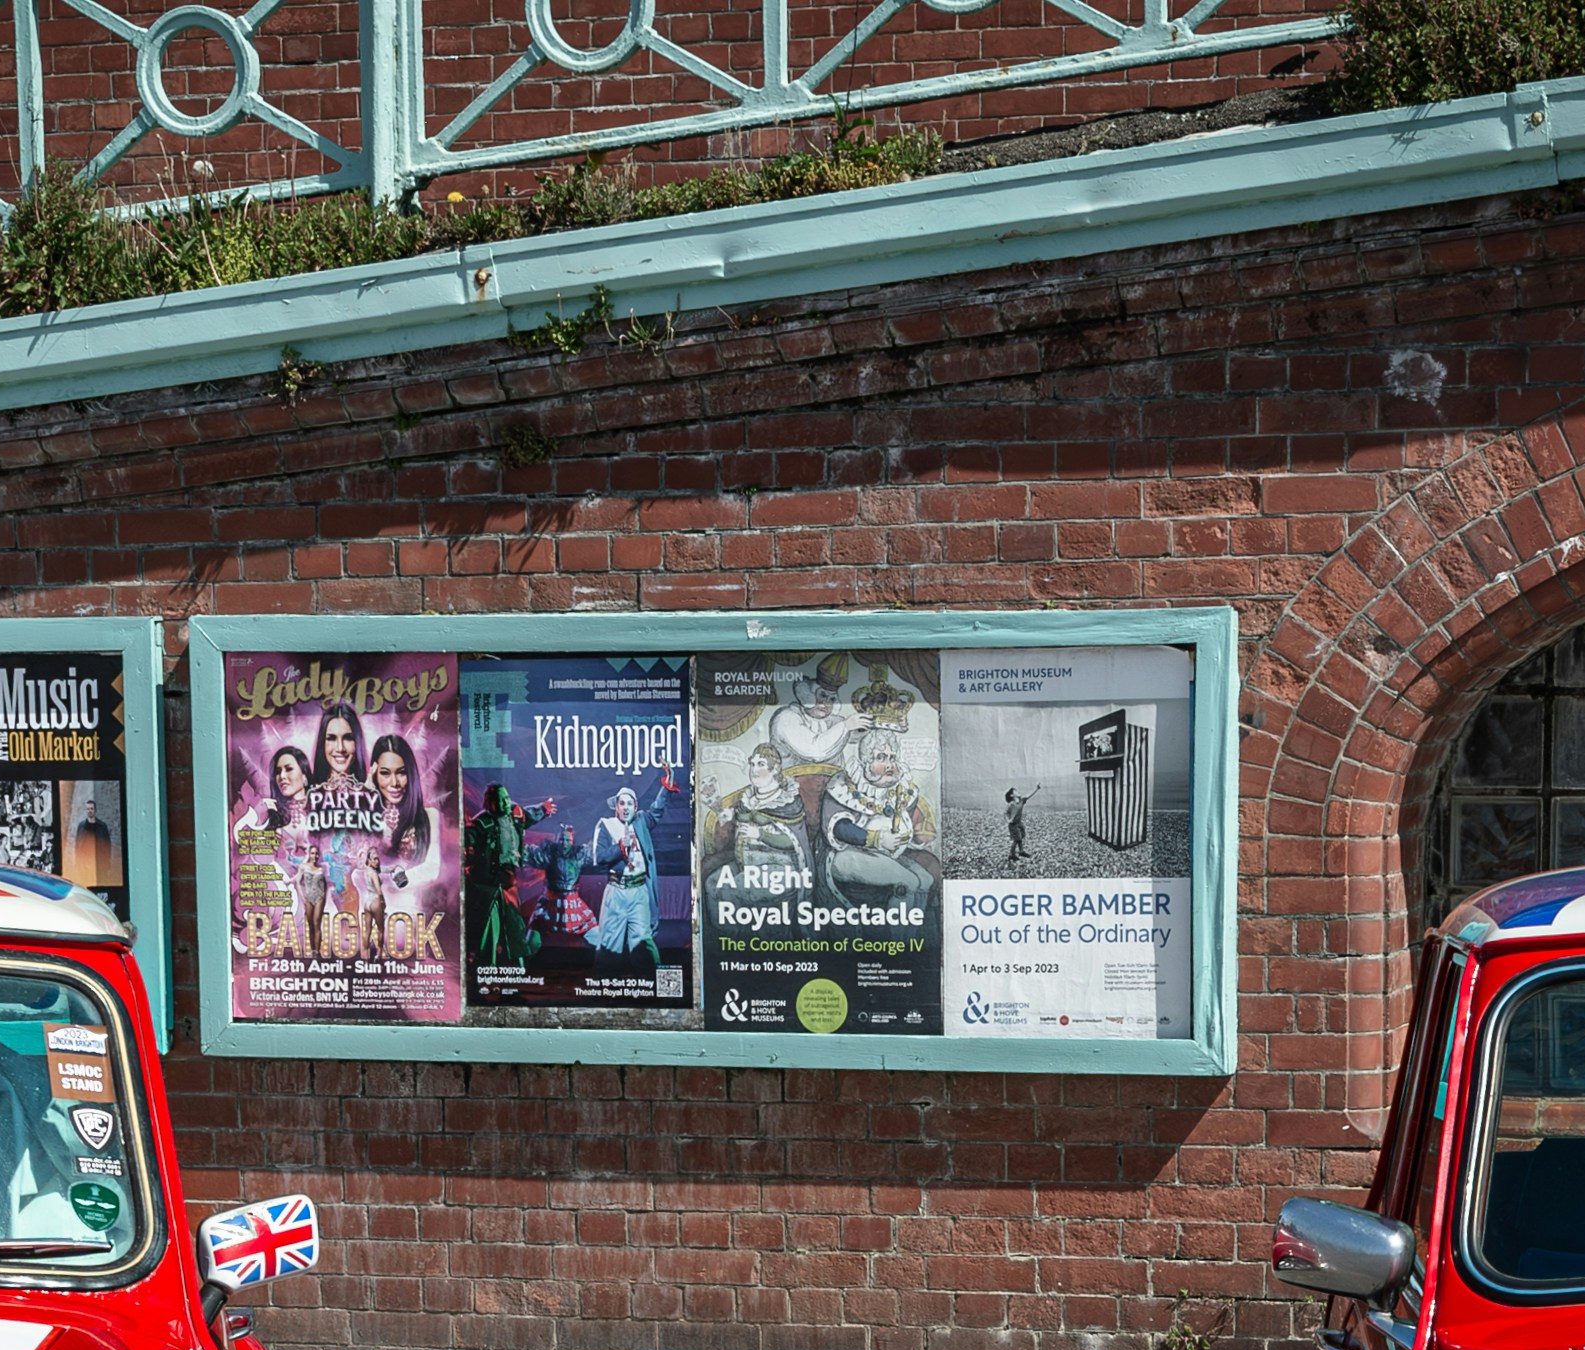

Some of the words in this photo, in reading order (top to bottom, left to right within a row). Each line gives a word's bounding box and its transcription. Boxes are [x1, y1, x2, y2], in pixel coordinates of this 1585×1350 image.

[283, 664, 301, 683] The
[714, 671, 751, 683] ROYAL
[752, 671, 804, 683] PAVILION
[958, 669, 1019, 680] BRIGHTON
[1021, 667, 1073, 679] MUSEUM
[236, 660, 351, 721] Lady
[345, 664, 449, 715] Boys
[548, 679, 553, 690] A
[618, 678, 647, 688] adventure
[647, 678, 663, 688] based
[671, 678, 681, 688] the
[714, 685, 723, 696] &
[724, 684, 772, 696] GARDEN
[958, 682, 967, 693] &
[969, 682, 991, 693] ART
[993, 681, 1044, 692] GALLERY
[610, 690, 617, 700] by
[617, 689, 636, 700] Robert
[637, 689, 652, 700] Louis
[652, 690, 681, 699] Stevenson
[483, 693, 491, 733] Brighton
[9, 731, 37, 762] Old
[38, 731, 101, 762] Market
[533, 714, 685, 776] Kidnapped
[309, 790, 380, 811] PARTY
[306, 809, 385, 833] QUEENS
[716, 865, 737, 889] A
[743, 864, 813, 895] Right
[961, 895, 1053, 917] ROGER
[1062, 893, 1171, 916] BAMBER
[718, 901, 792, 932] Royal
[797, 901, 925, 932] Spectacle
[961, 924, 1002, 944] Out
[1008, 924, 1031, 944] of
[1037, 924, 1072, 944] the
[1078, 923, 1172, 948] Ordinary
[718, 937, 746, 952] The
[749, 937, 826, 952] Coronation
[833, 936, 849, 952] of
[852, 938, 906, 956] George
[909, 938, 925, 952] IV
[248, 959, 268, 973] Fri
[271, 960, 304, 974] 28th
[308, 960, 344, 976] April
[354, 960, 382, 975] Sun
[383, 961, 409, 975] 11th
[411, 961, 444, 975] June
[477, 967, 498, 975] 01273
[499, 967, 526, 975] 709709
[719, 961, 729, 971] 11
[731, 961, 749, 971] Mar
[751, 962, 761, 971] to
[763, 962, 774, 972] 10
[775, 962, 794, 974] Sep
[795, 962, 819, 973] 2023
[962, 964, 967, 974] 1
[969, 964, 989, 976] Apr
[990, 964, 1002, 974] to
[1004, 964, 1011, 974] 3
[1013, 964, 1033, 975] Sep
[1034, 963, 1060, 974] 2023
[249, 976, 349, 992] BRIGHTON
[382, 978, 401, 986] April
[477, 975, 545, 986] brightonfestival.org
[585, 978, 601, 987] Thu
[601, 978, 626, 987] 18-Sat
[626, 978, 637, 987] 20
[637, 978, 655, 989] May
[249, 991, 281, 1002] Victoria
[281, 991, 315, 1003] Gardens,
[316, 992, 332, 1003] BN1
[332, 992, 349, 1003] 1UG
[352, 989, 445, 999] ladyboysofbangkok.co.uk
[574, 987, 602, 996] Theatre
[603, 988, 623, 998] Royal
[623, 988, 654, 999] Brighton
[751, 999, 787, 1007] BRIGHTON
[751, 1015, 785, 1023] MUSEUMS
[993, 1009, 999, 1017] &
[999, 1009, 1019, 1017] HOVE
[993, 1017, 1027, 1025] MUSEUMS
[63, 1029, 89, 1040] 2023
[50, 1036, 74, 1046] LONDON
[74, 1039, 105, 1049] BRIGHTON
[57, 1062, 103, 1079] LSMOC
[61, 1077, 103, 1093] STAND
